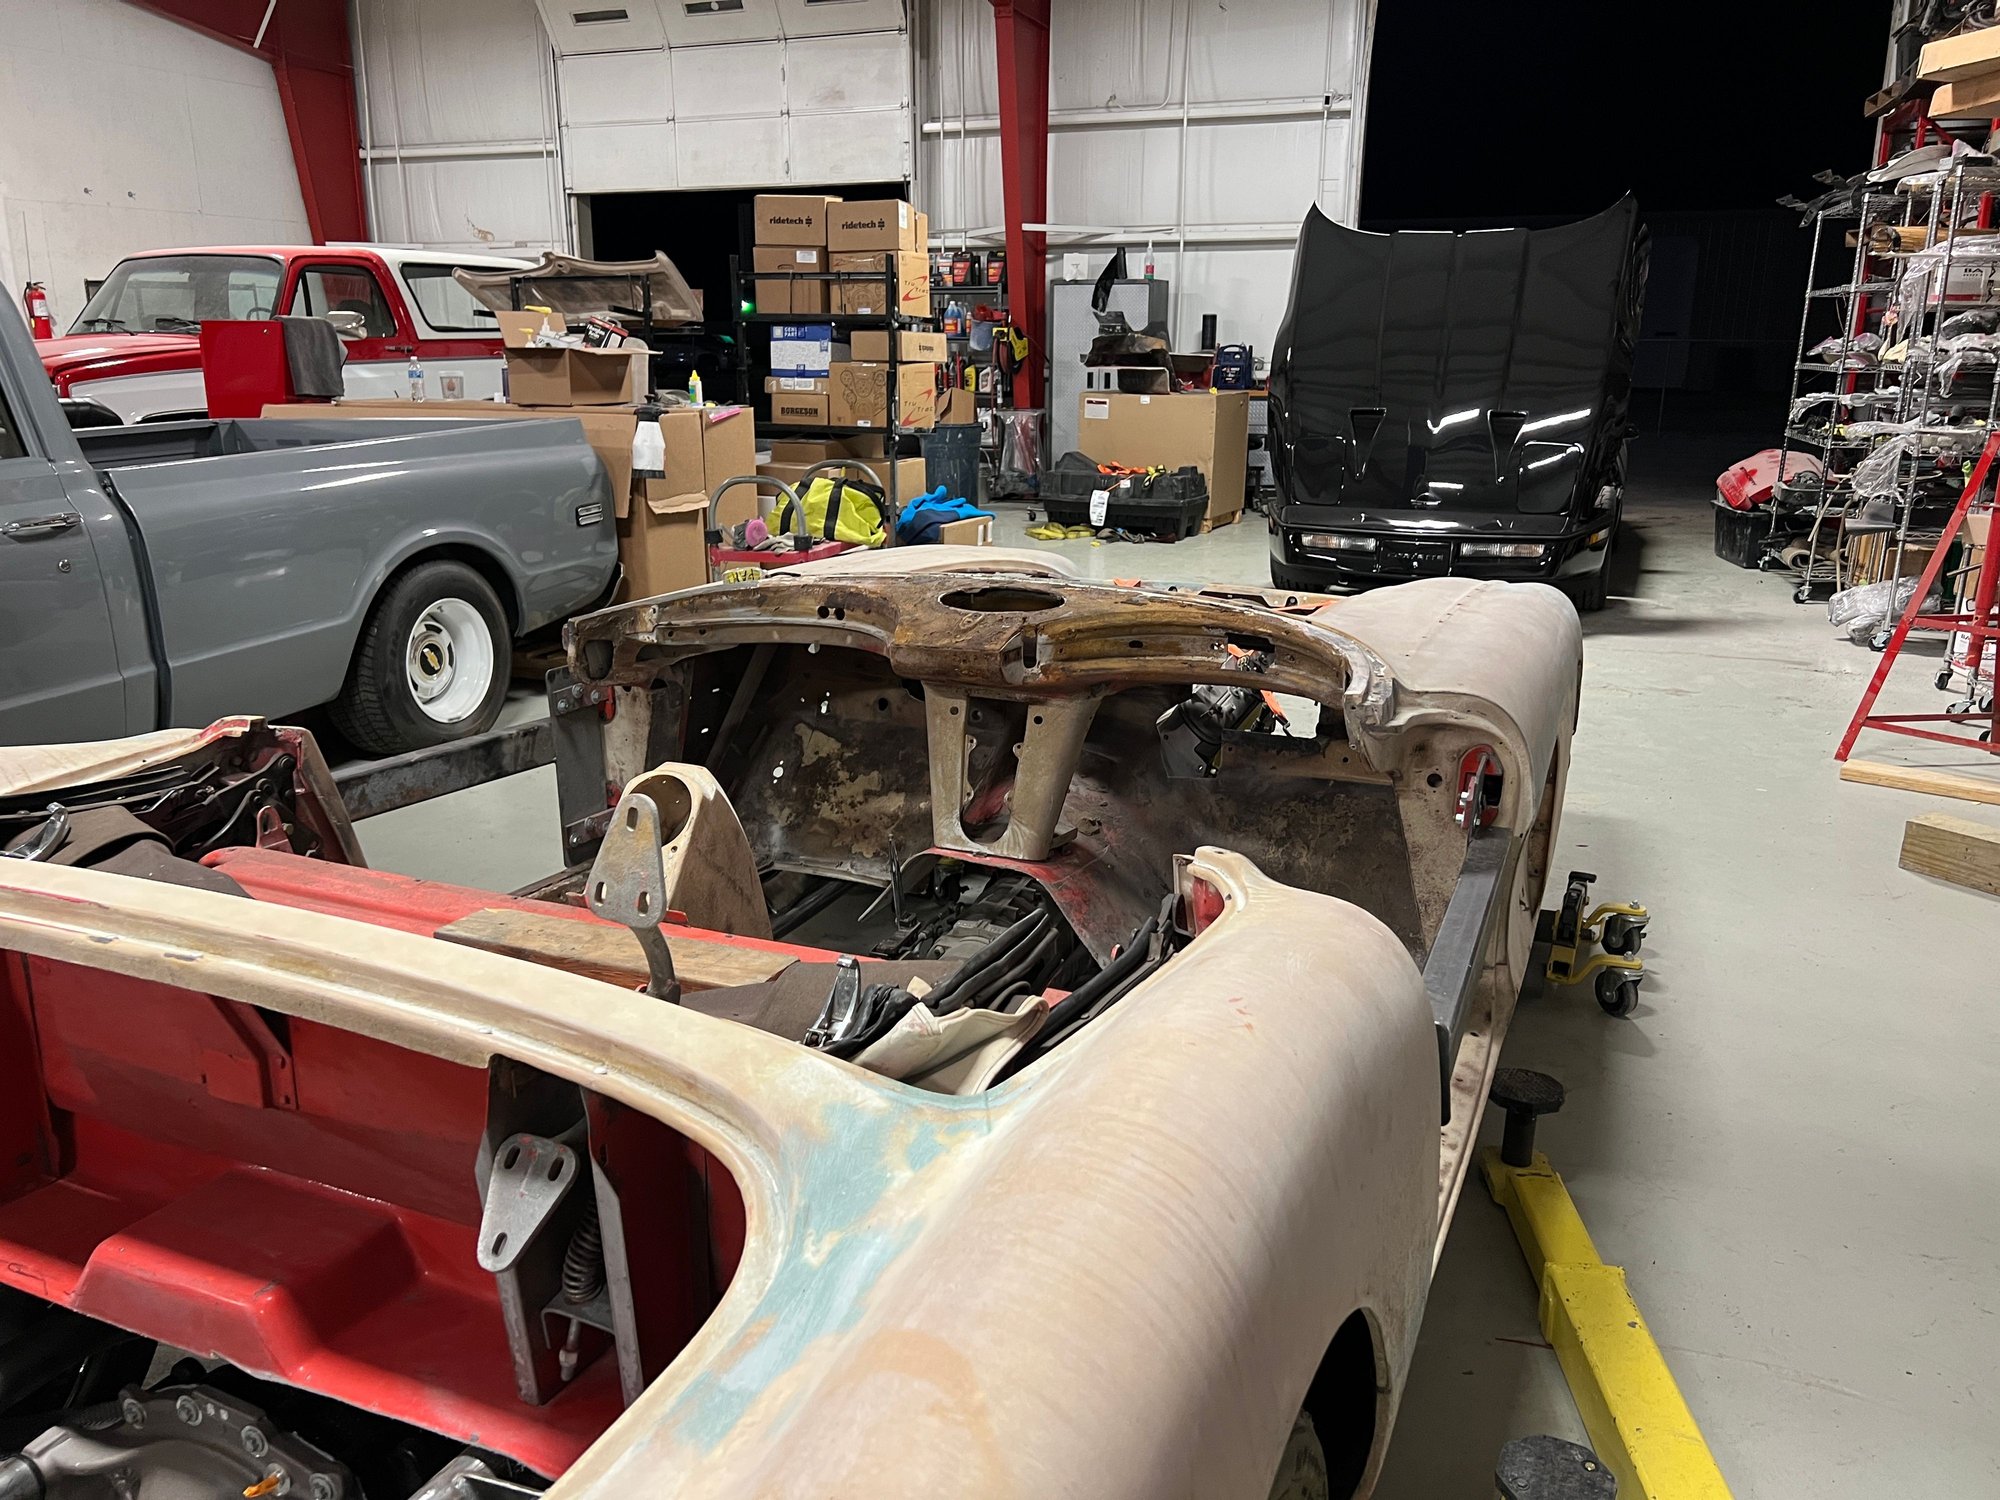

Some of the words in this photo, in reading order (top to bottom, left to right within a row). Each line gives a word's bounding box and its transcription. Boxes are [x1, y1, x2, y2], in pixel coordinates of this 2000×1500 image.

[769, 215, 804, 225] ridetech
[841, 220, 877, 230] ridetech
[780, 406, 819, 417] BORGESON
